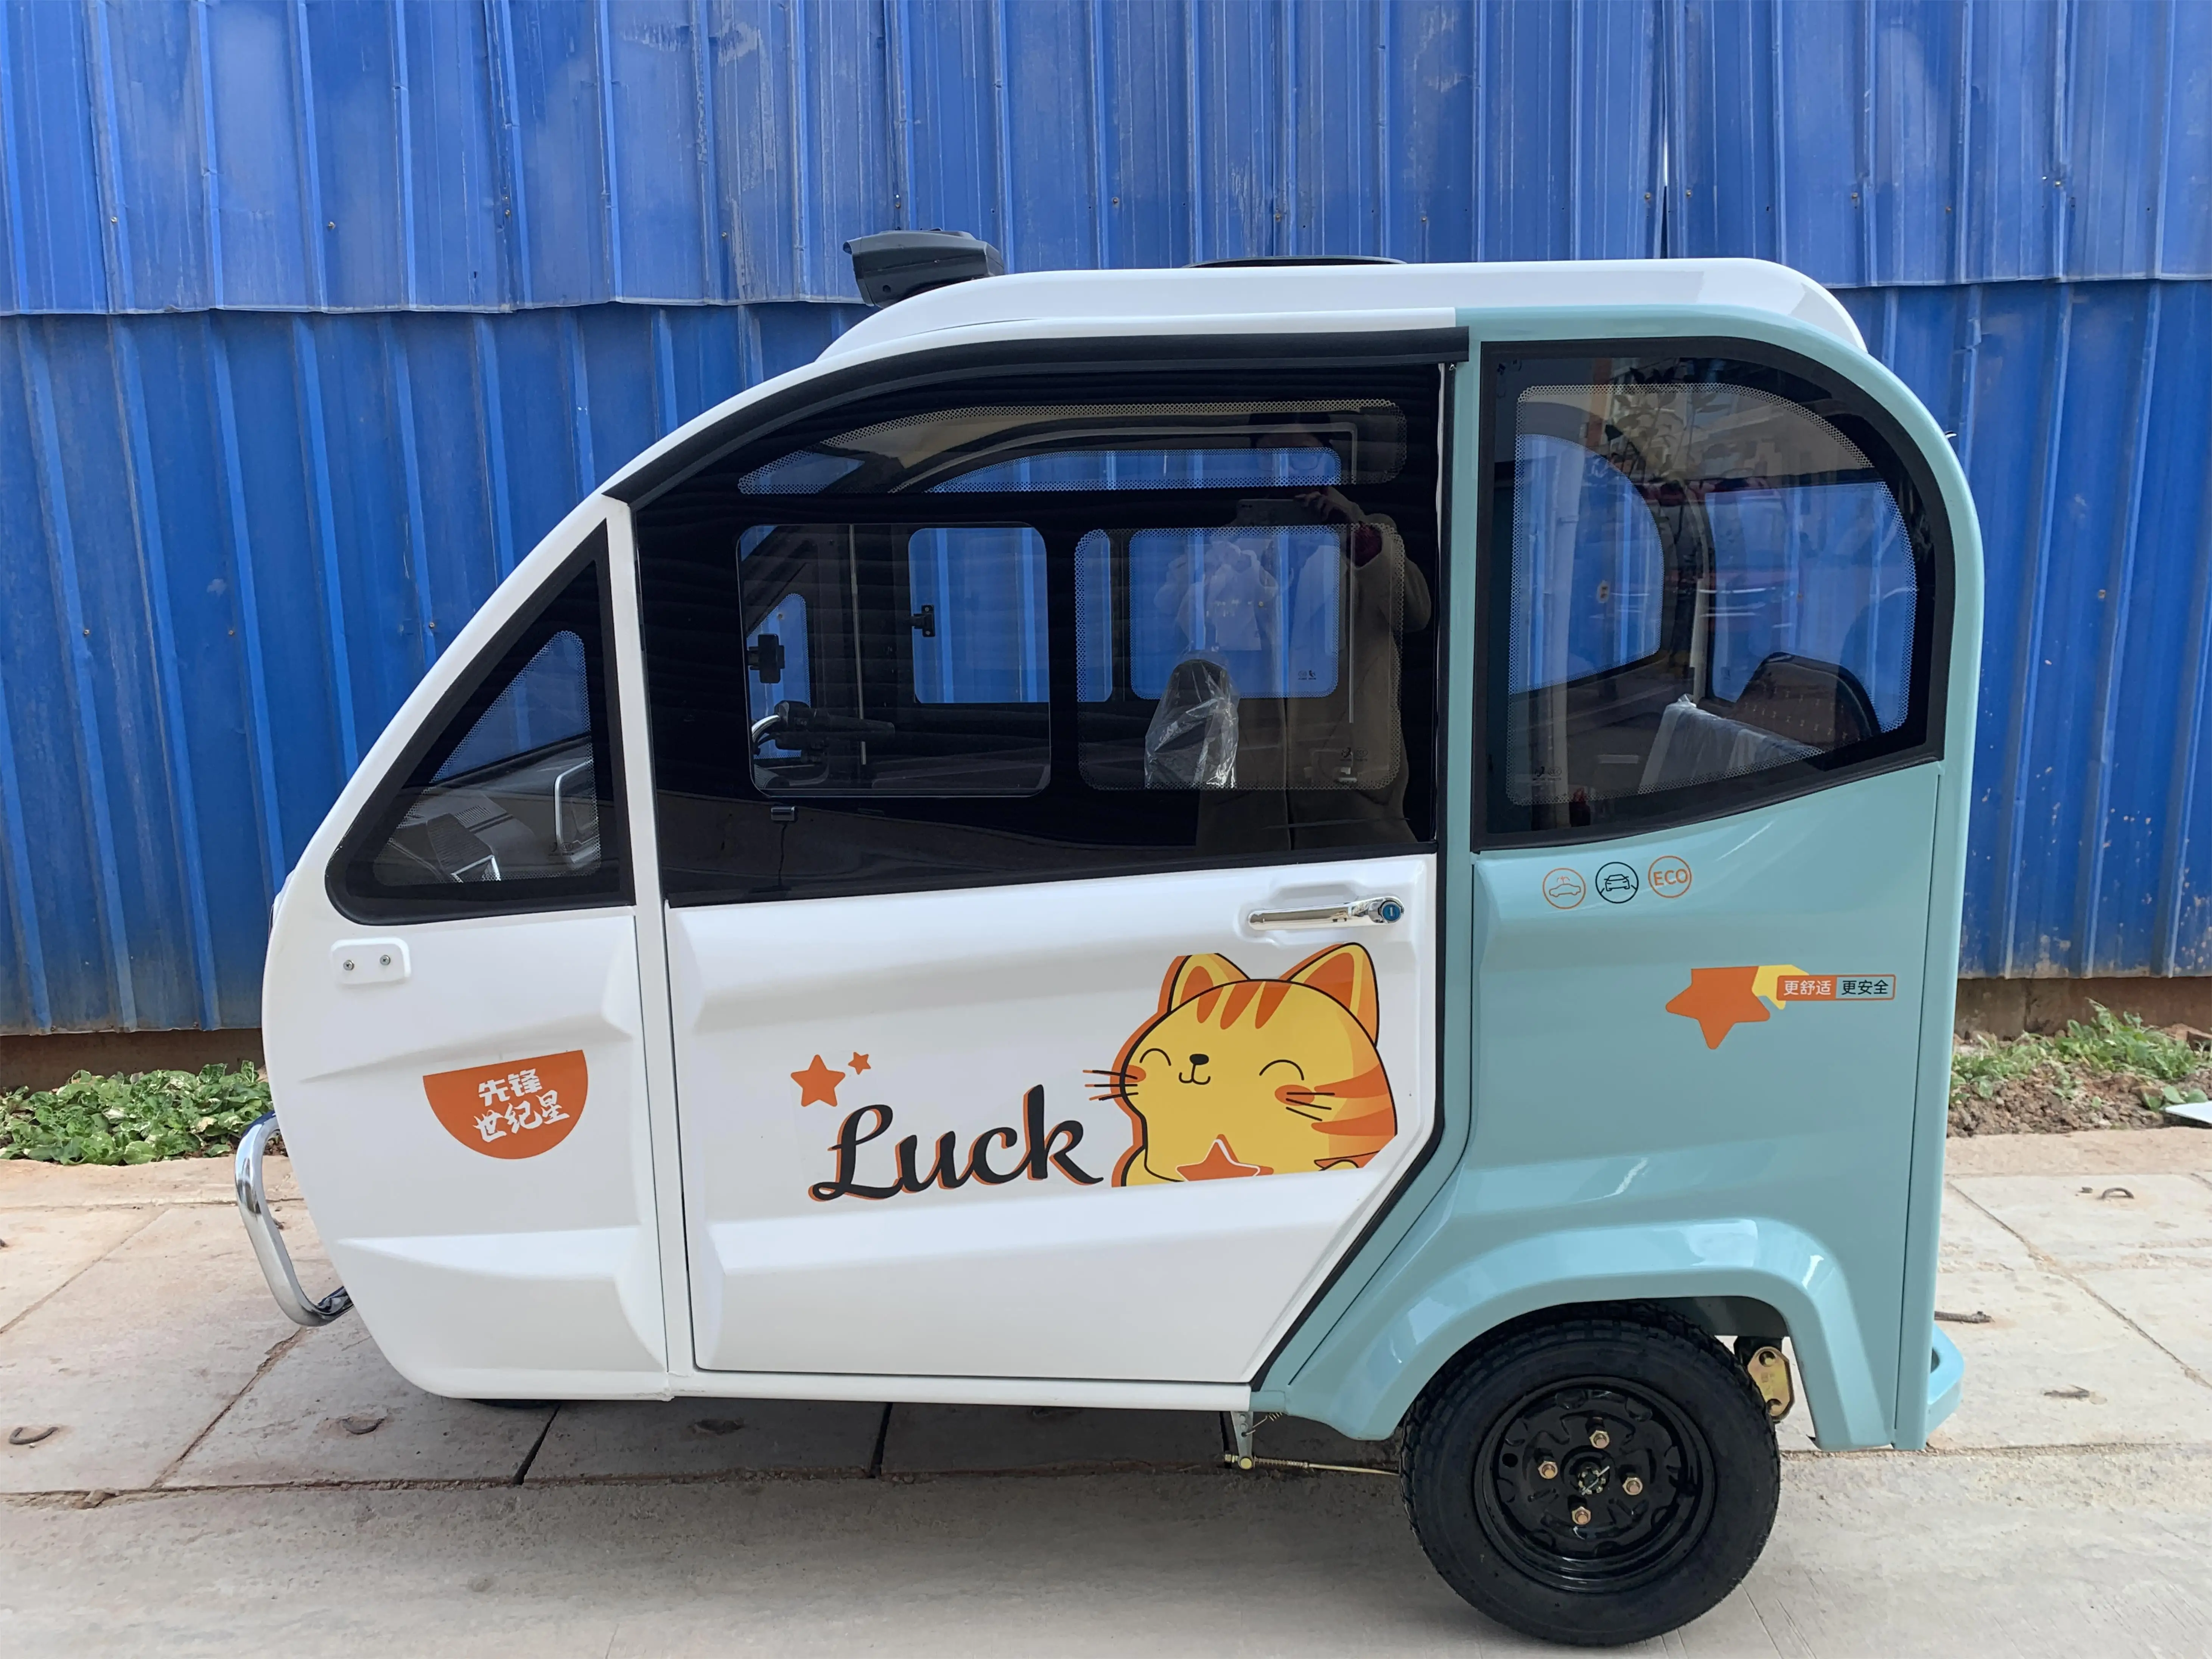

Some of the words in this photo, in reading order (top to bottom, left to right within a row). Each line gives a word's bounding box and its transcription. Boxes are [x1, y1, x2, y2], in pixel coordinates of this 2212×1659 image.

[1654, 868, 1689, 886] ECO
[1783, 980, 1831, 996] 更舒适
[1841, 979, 1889, 995] 更安全
[478, 1068, 543, 1107] 先锋
[473, 1089, 570, 1143] 世纪星
[808, 1084, 1104, 1202] Luck
